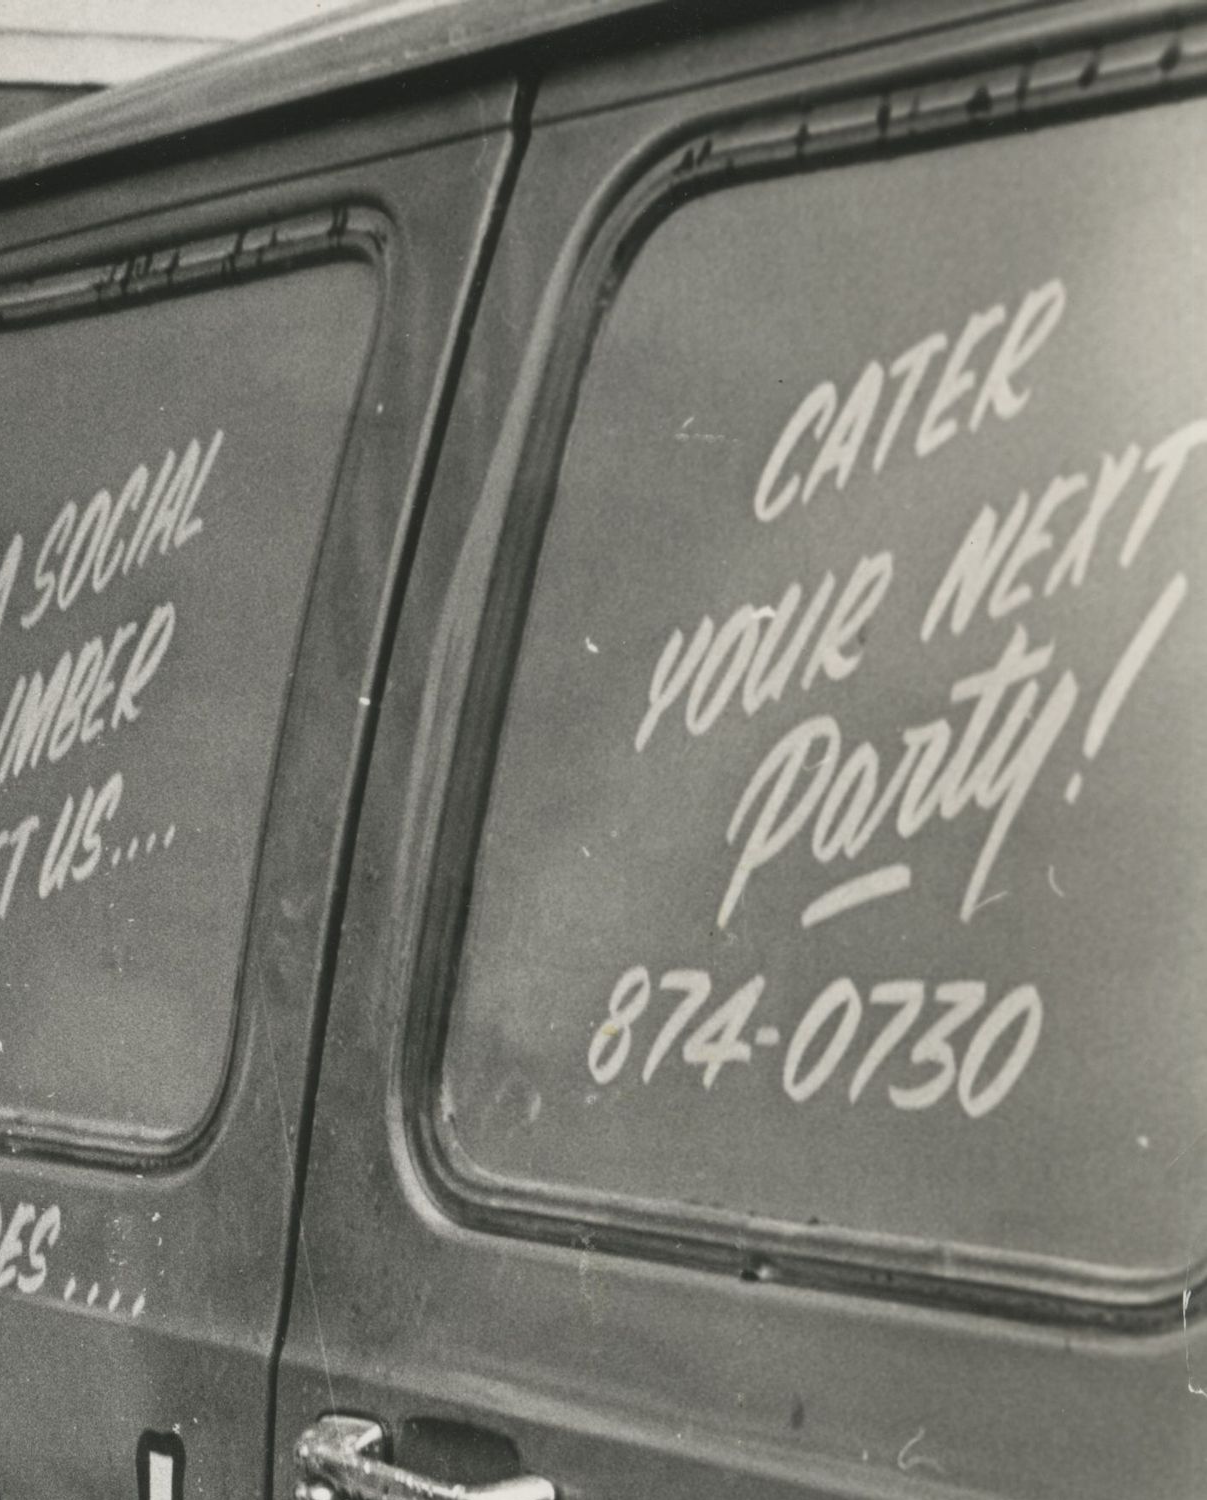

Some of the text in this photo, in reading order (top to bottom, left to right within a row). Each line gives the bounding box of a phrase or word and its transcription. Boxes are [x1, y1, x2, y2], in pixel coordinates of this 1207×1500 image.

[754, 278, 1066, 522] CATER
[21, 428, 224, 629] SOCIAL
[634, 418, 1207, 752] YOUR NEXT
[588, 965, 1042, 1118] 874-0730
